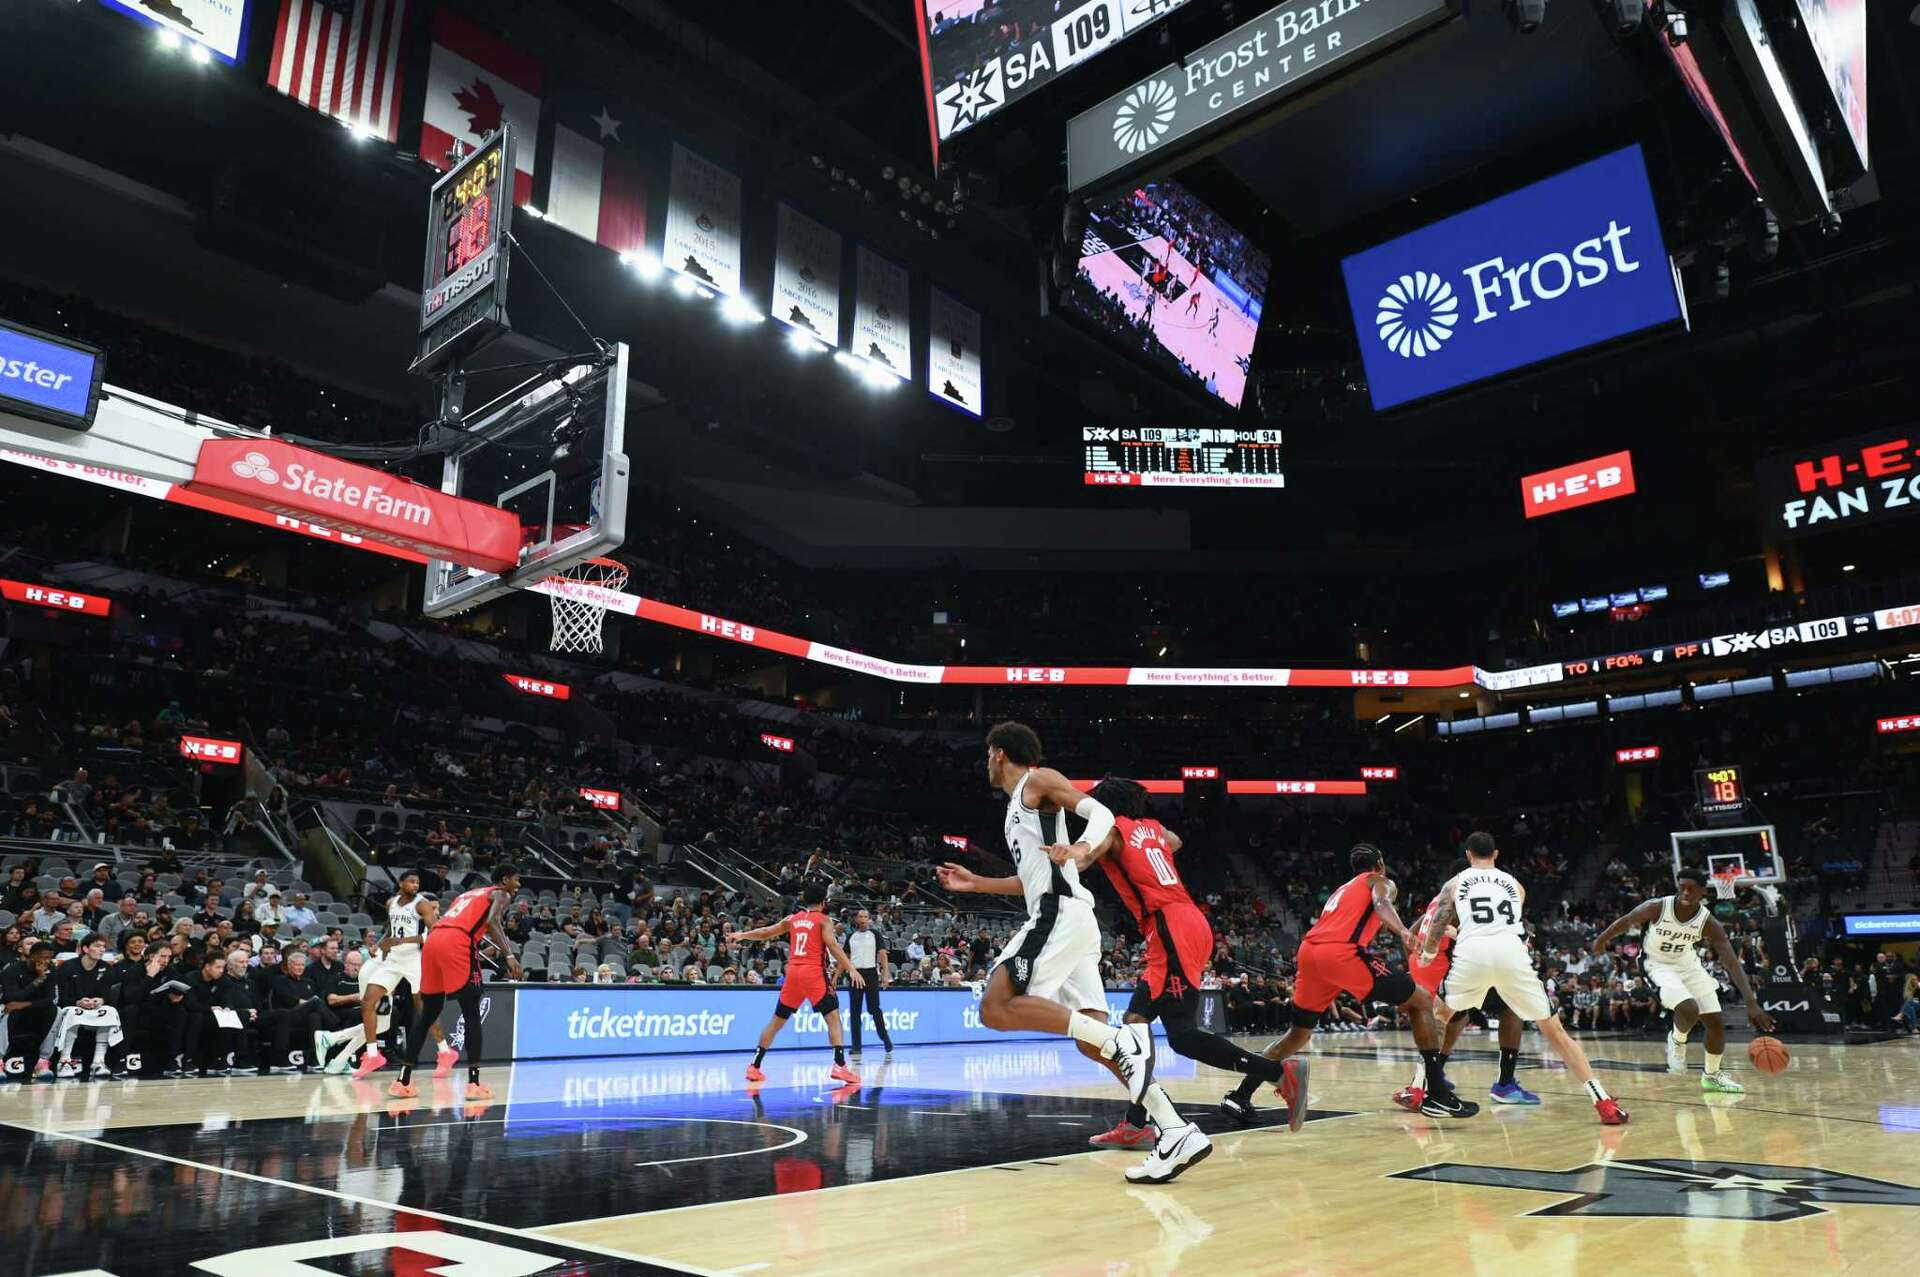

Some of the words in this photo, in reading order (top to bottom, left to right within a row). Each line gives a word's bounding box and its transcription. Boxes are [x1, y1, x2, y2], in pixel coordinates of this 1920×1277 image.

[1005, 41, 1051, 90] SA
[1064, 5, 1111, 56] 109
[1184, 30, 1269, 97] Frost
[1275, 0, 1371, 49] Ban
[1209, 31, 1342, 109] CENTER
[443, 255, 494, 302] TISSOT
[1463, 219, 1640, 324] Frost
[1121, 429, 1138, 440] SA
[1143, 429, 1163, 441] 109
[1235, 431, 1257, 442] HOU
[1262, 431, 1277, 443] 94
[1532, 465, 1622, 505] H-E-B
[1783, 486, 1869, 529] FAN
[25, 587, 86, 609] H-E-B
[701, 614, 756, 642] H-E-B
[1565, 662, 1588, 676] TO
[1605, 653, 1643, 670] FG%
[1675, 644, 1699, 659] PF
[1769, 628, 1800, 646] SA
[1809, 621, 1840, 640] 109
[823, 649, 843, 663] Here
[845, 656, 894, 675] Everything's
[1006, 668, 1066, 682] H-E-B
[1147, 672, 1172, 681] Here
[1174, 672, 1239, 683] Everything's
[1241, 672, 1278, 682] Better.
[1351, 671, 1409, 684] H-E-B
[184, 740, 237, 759] H-E-B
[1618, 748, 1656, 761] H-E-B
[1276, 782, 1315, 793] H-E-B
[1708, 769, 1736, 783] 4:07
[1714, 782, 1736, 801] 18
[1469, 896, 1515, 925] 54
[795, 932, 808, 956] 12
[567, 1006, 735, 1039] ticketmaster
